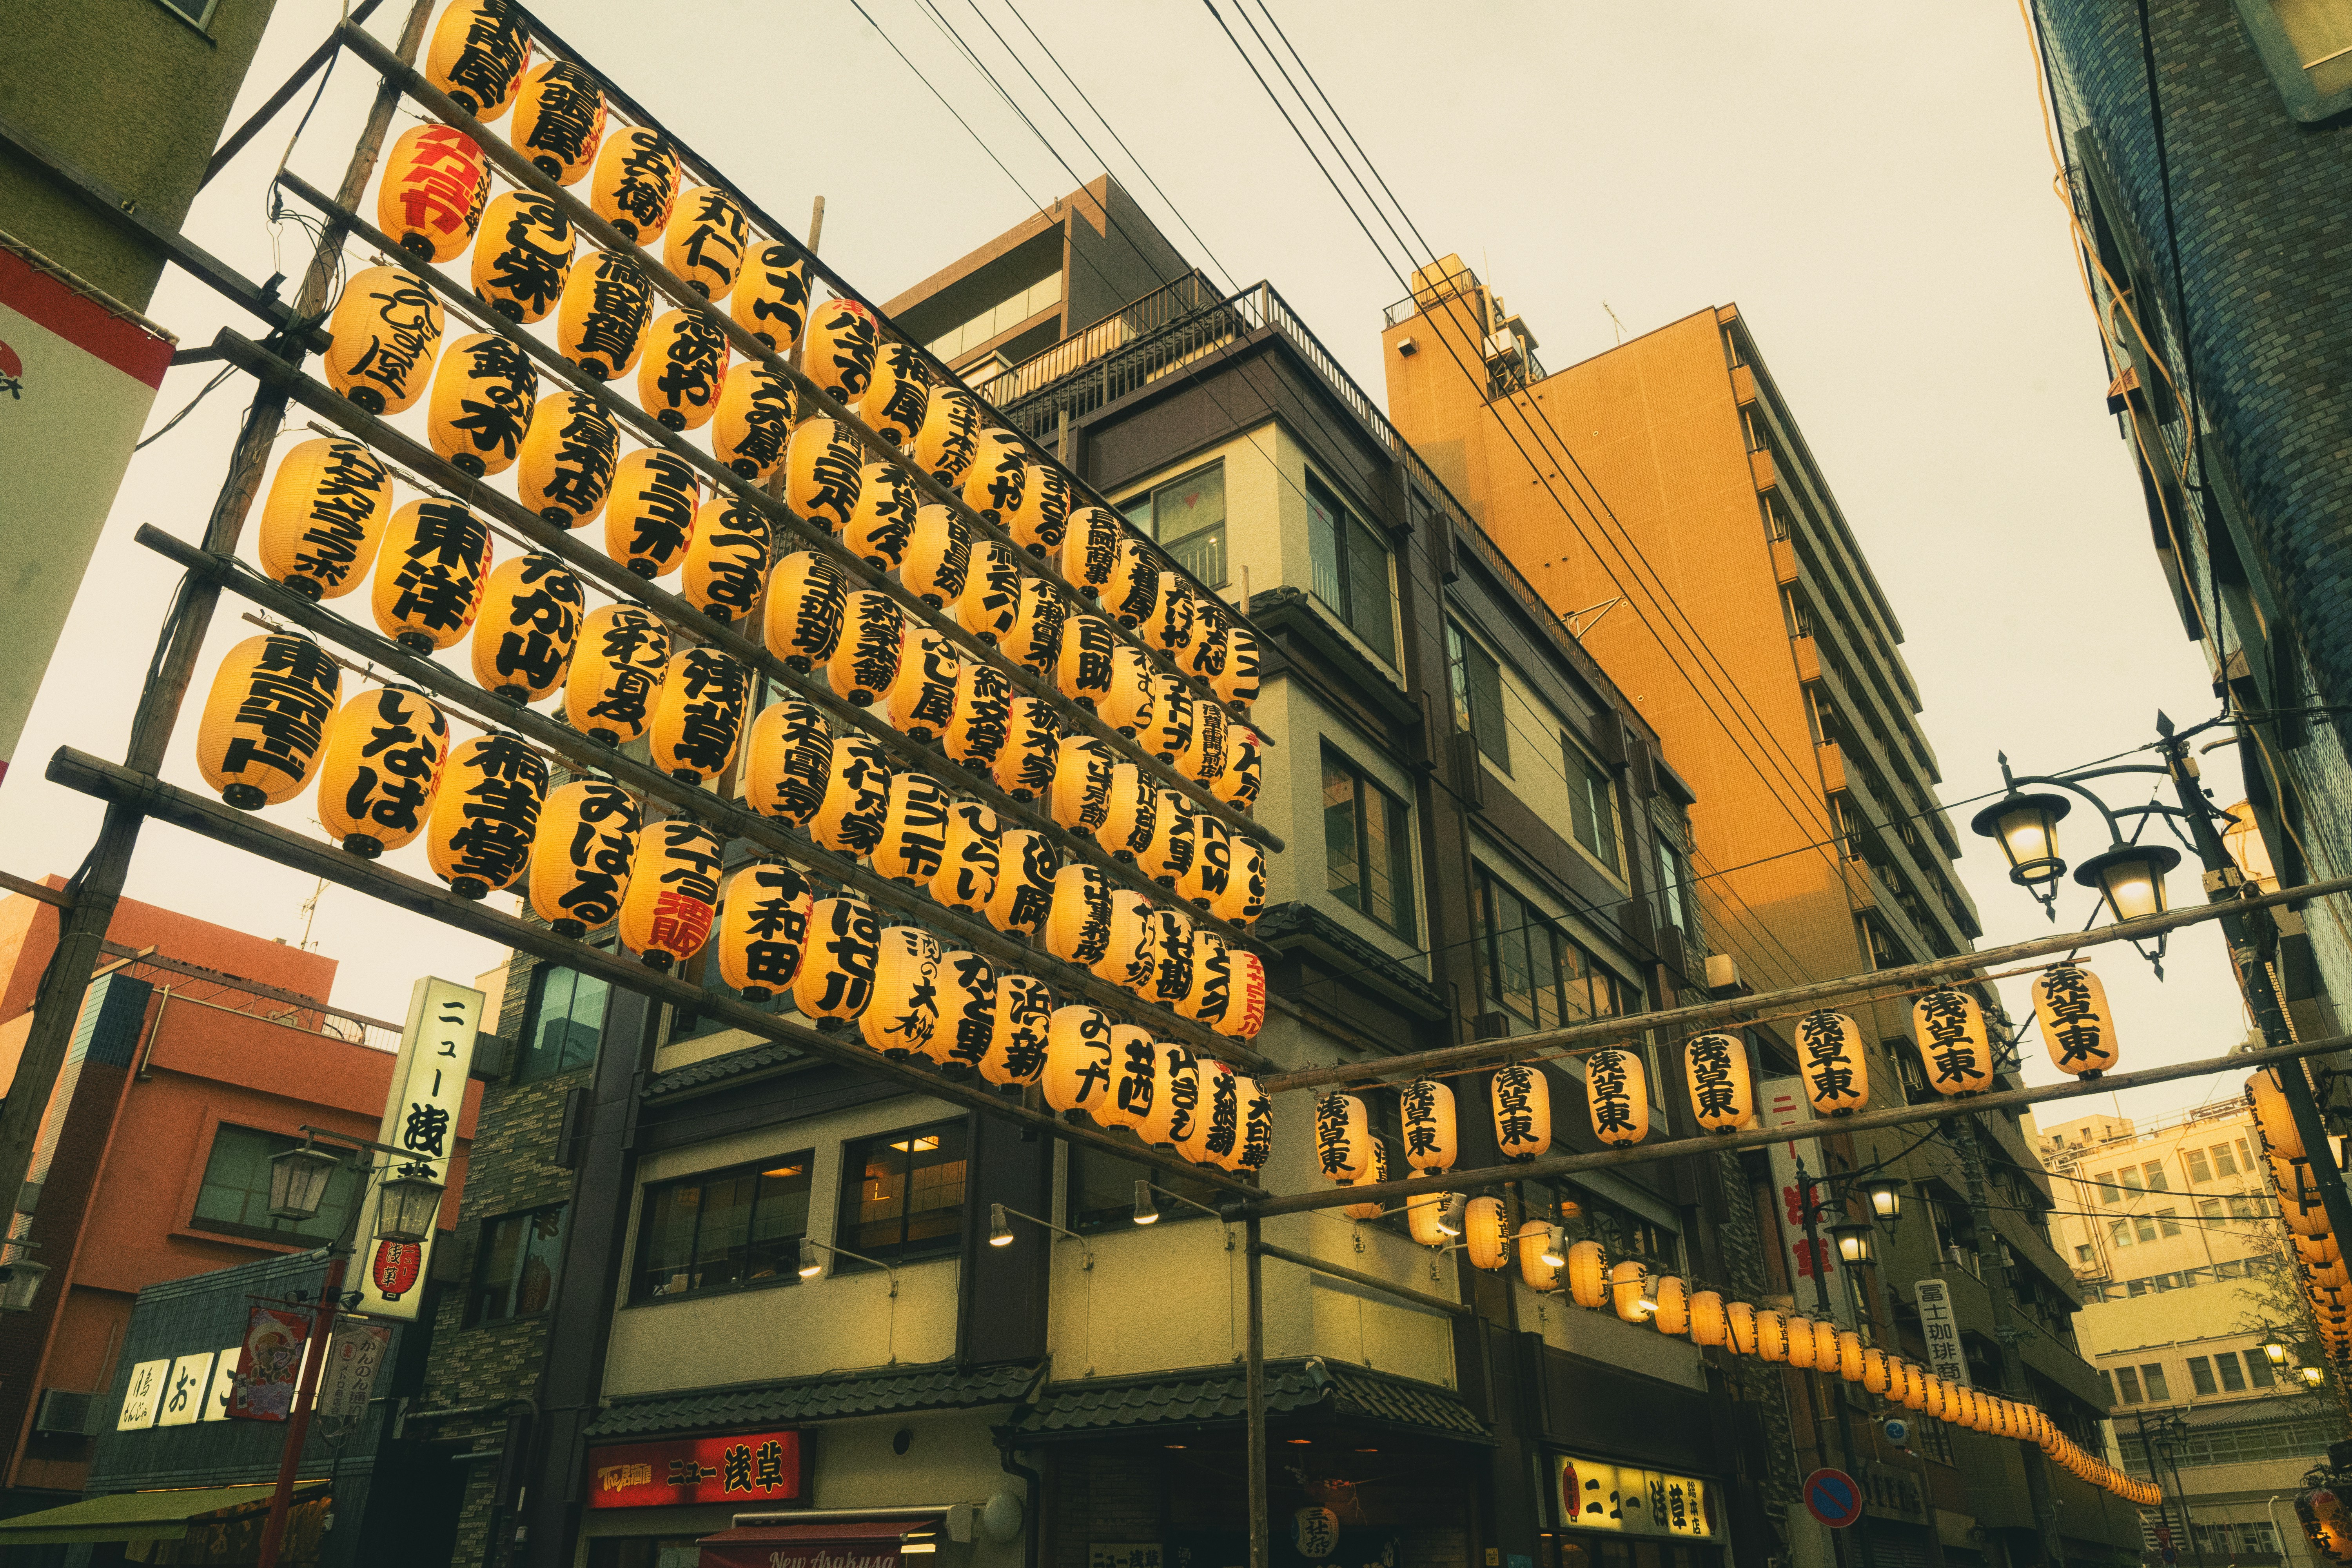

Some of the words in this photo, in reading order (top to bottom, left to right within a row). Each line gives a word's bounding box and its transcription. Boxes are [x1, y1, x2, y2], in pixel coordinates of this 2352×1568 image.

[526, 62, 601, 165] 尾張屋
[400, 125, 483, 235] オカダヤ
[682, 195, 742, 284] 丸仁
[348, 276, 439, 398] えびす屋
[452, 338, 535, 459] 鉢の木
[988, 435, 1029, 515] つるや
[1035, 468, 1072, 546] まさる
[393, 504, 485, 630] 東洋
[497, 558, 583, 688] なか山
[853, 595, 902, 695] 木村家本舗
[1076, 619, 1116, 691] 百助
[1193, 603, 1229, 679] 福ちゃん
[674, 650, 747, 776] 浅草
[911, 632, 958, 727] ふじ屋
[964, 662, 1010, 766] 紀文堂
[347, 690, 444, 832] いなば
[450, 737, 548, 885] 桐生堂
[957, 806, 1002, 902] ひらい
[559, 786, 639, 927] みはる
[647, 891, 713, 958] 酒販
[746, 868, 809, 985] 十和田
[816, 900, 880, 1018] はせ川
[1072, 868, 1115, 965] 中山事務所
[1123, 904, 1157, 986] やげん堀
[1802, 1013, 1860, 1102] 浅草東
[1920, 992, 1984, 1083] 浅草東
[2040, 967, 2109, 1065] 浅草東
[1403, 1082, 1441, 1157] 浅草東
[1496, 1067, 1539, 1146] 浅草東
[1590, 1051, 1636, 1134] 浅草東
[1691, 1032, 1739, 1117] 浅草東
[1316, 1095, 1355, 1173] 浅草東
[381, 1245, 403, 1287] 浅草
[169, 1366, 196, 1412] お
[667, 1439, 784, 1494] ニュー浅草
[1585, 1479, 1687, 1530] ニュー浅草
[769, 1551, 806, 1568] New
[808, 1550, 896, 1568] Asakusa
[1306, 1509, 1330, 1555] 三社祭
